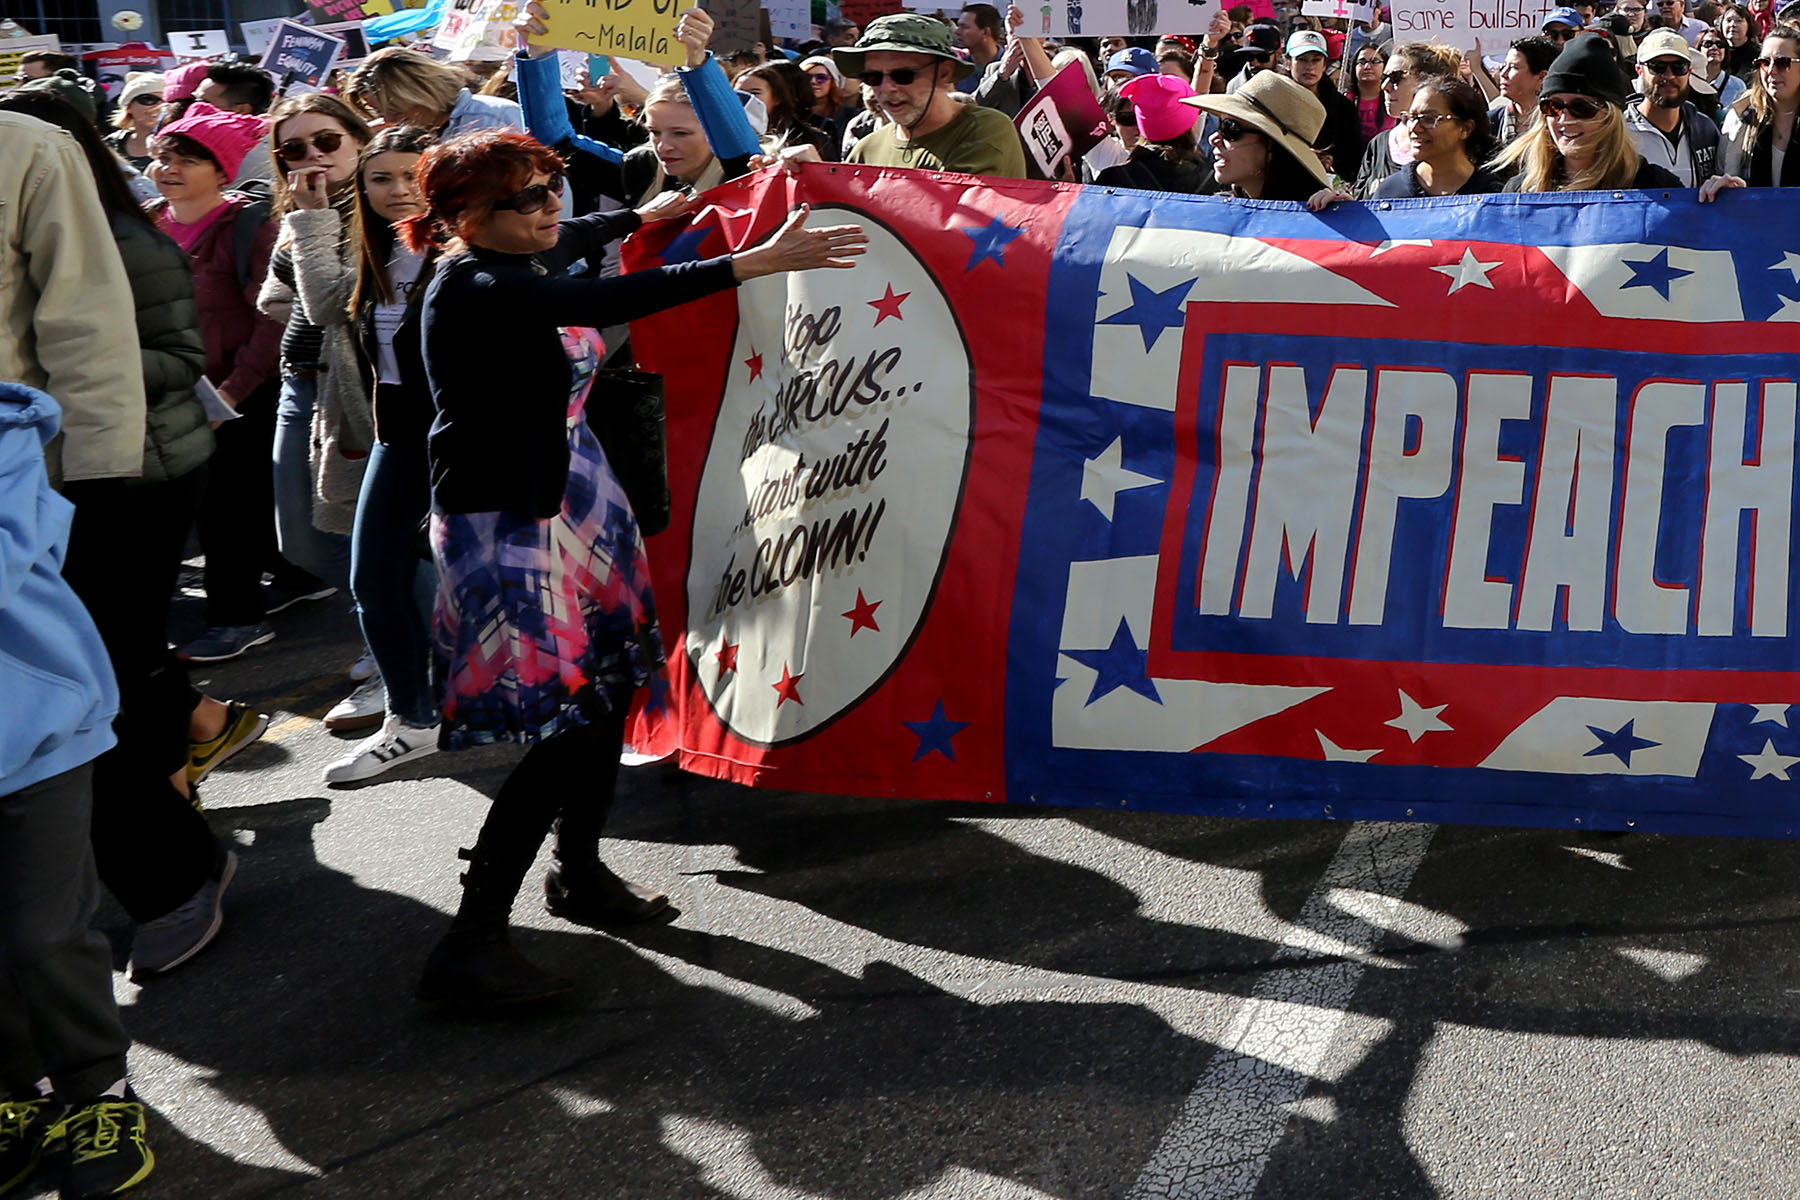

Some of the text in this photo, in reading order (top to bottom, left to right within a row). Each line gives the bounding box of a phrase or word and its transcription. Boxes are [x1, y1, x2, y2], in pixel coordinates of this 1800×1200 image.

[1397, 8, 1455, 32] same
[805, 418, 889, 500] with
[1195, 361, 1798, 637] IMPEACH
